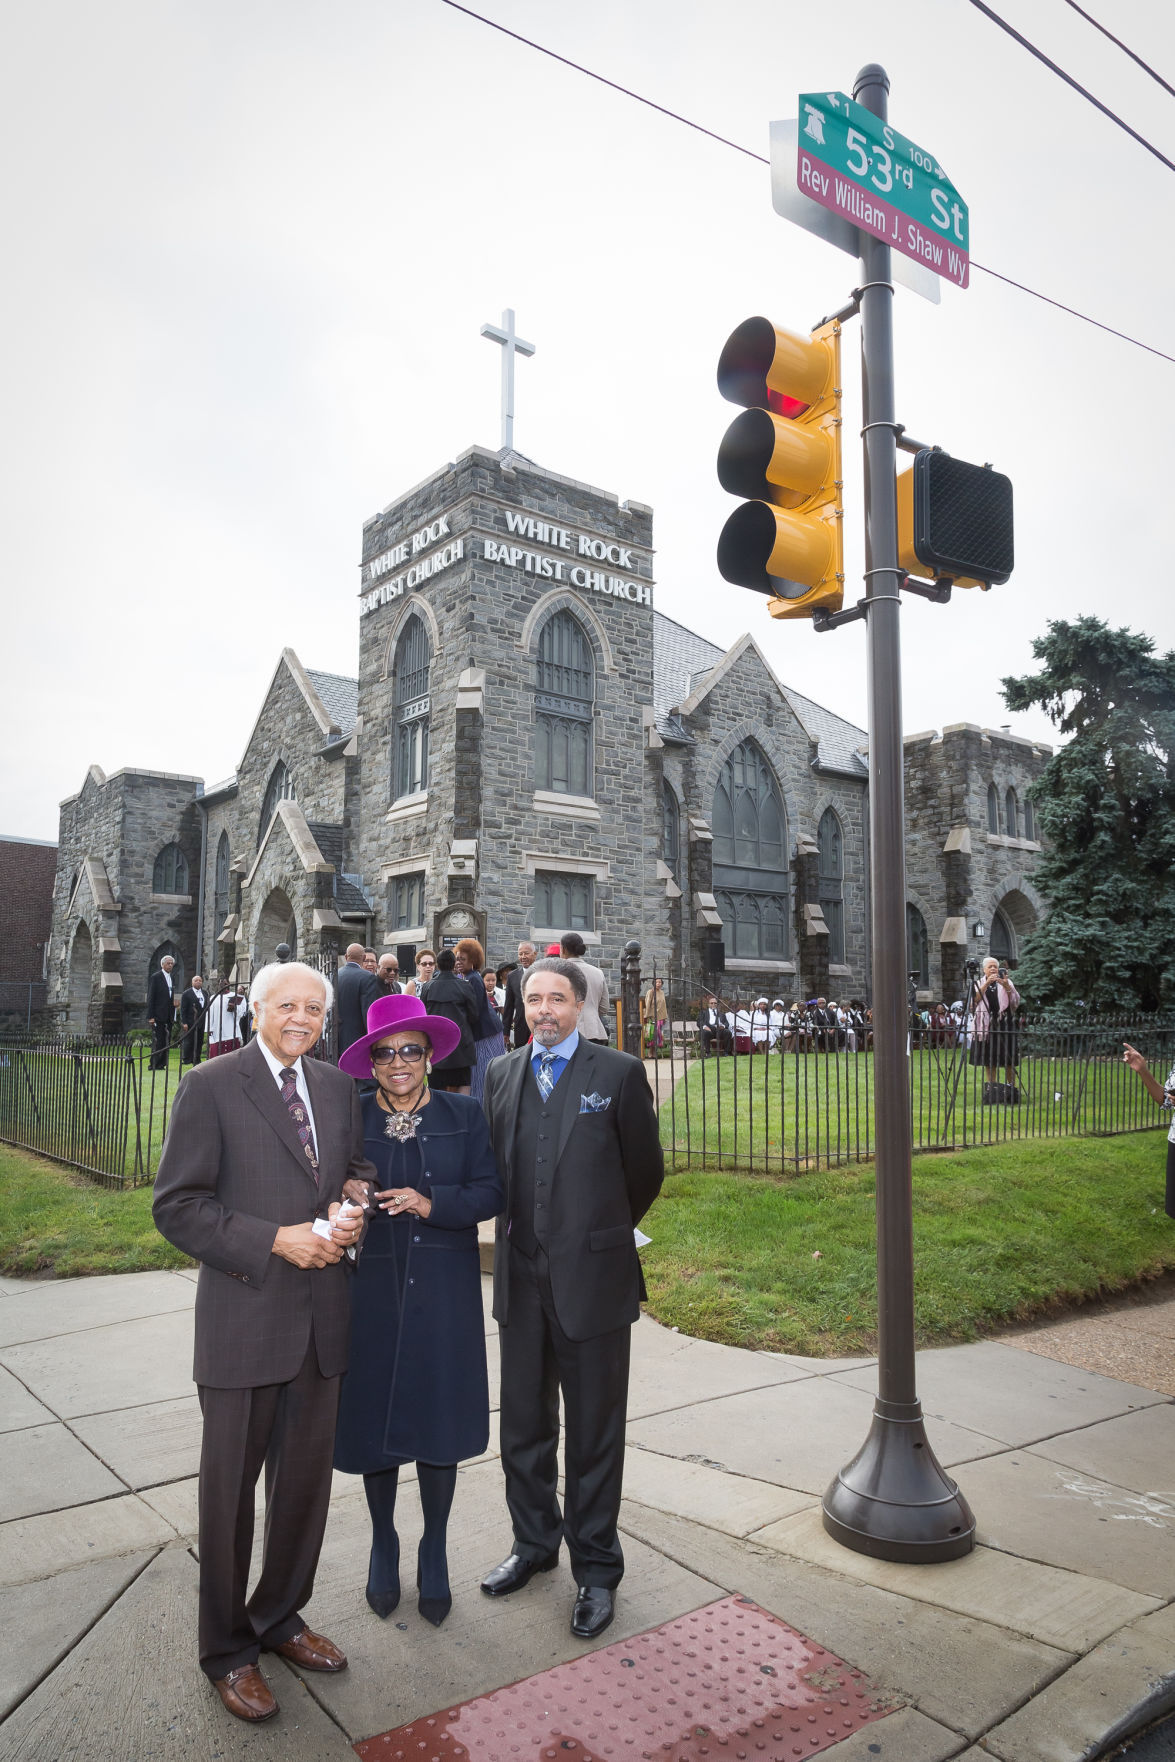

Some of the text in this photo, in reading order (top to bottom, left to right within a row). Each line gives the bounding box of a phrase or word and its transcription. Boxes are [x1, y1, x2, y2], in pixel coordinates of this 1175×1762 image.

[844, 103, 933, 173] 1 S 100
[846, 127, 964, 241] 53rd St
[801, 156, 967, 286] Rev William J. Shaw Wy
[369, 514, 450, 579] WHITE ROCK
[483, 539, 651, 606] BAPTIST CHURCH
[505, 510, 633, 569] WHITE ROCK
[360, 539, 464, 616] BAPTIST CHURCH
